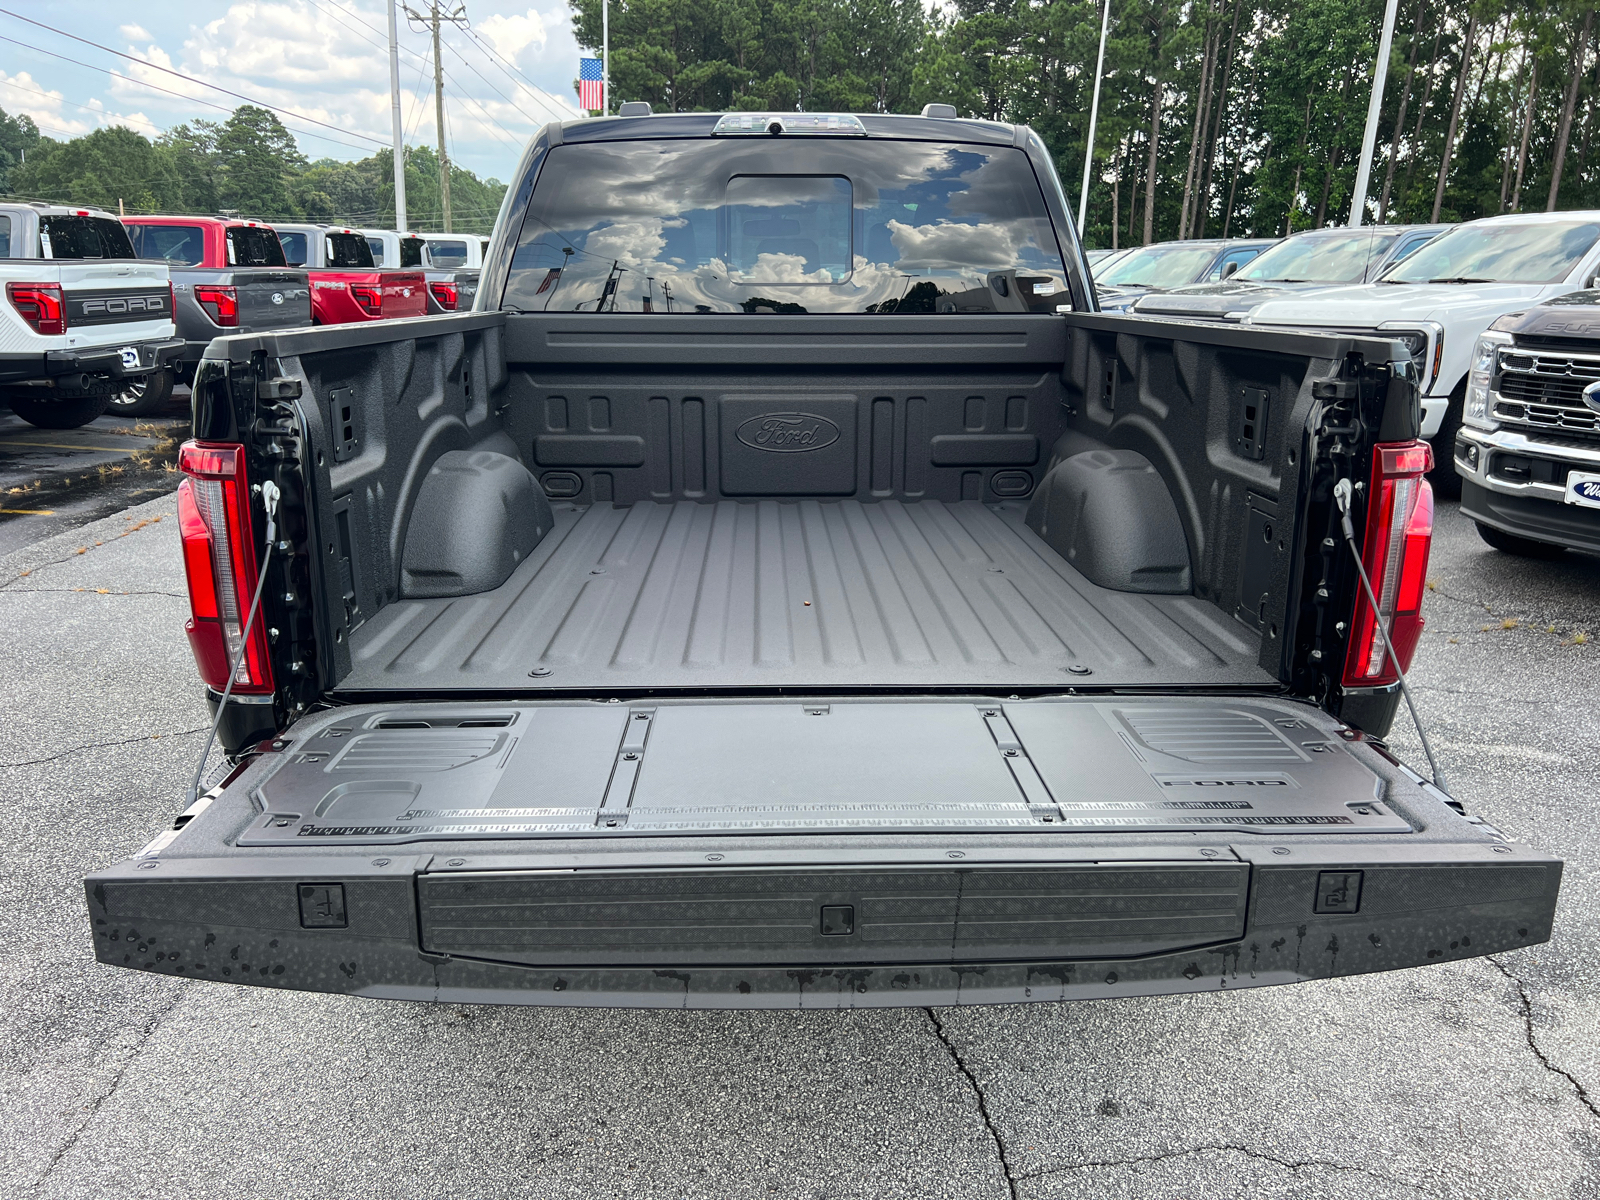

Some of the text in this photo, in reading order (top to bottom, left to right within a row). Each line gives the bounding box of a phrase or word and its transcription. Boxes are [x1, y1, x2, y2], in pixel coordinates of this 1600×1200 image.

[314, 281, 345, 290] FX4
[82, 298, 164, 315] FORD
[755, 417, 820, 445] Ford
